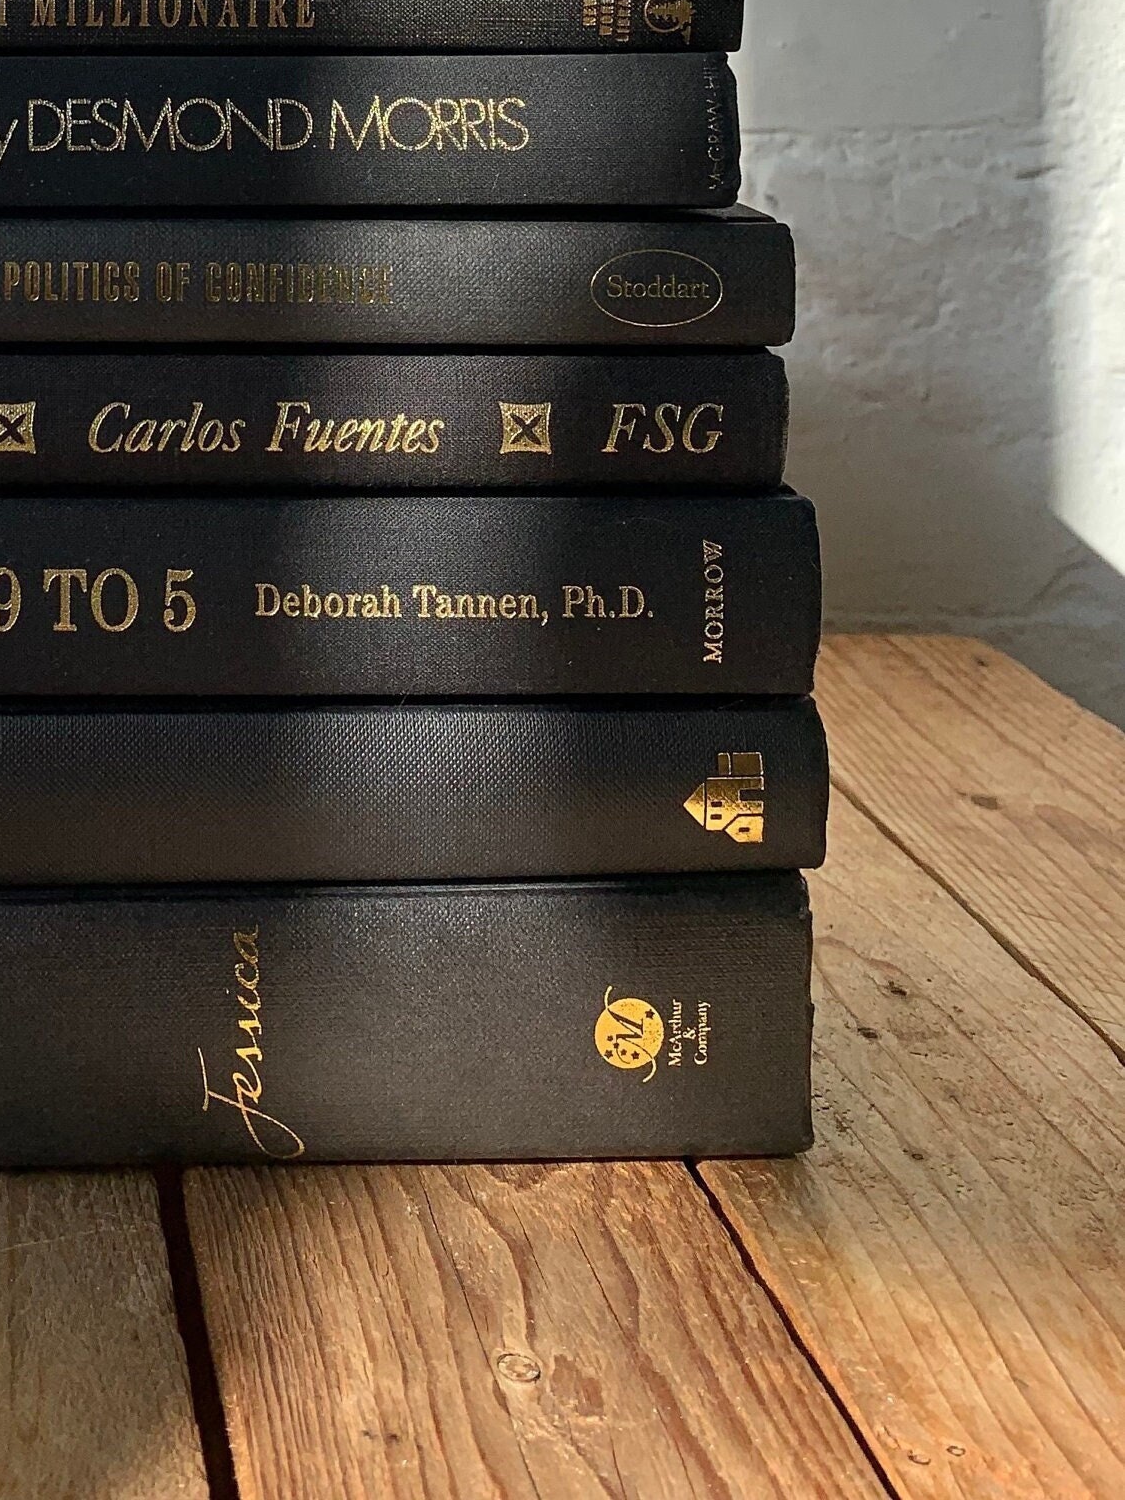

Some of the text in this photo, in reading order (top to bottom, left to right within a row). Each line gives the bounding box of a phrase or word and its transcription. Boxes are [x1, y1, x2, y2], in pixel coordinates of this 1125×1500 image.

[27, 97, 313, 152] DESMOND
[331, 97, 529, 151] MORRIS
[3, 260, 141, 303] POLITICS
[156, 263, 192, 302] OF
[205, 262, 393, 303] CONFIDENCE
[607, 274, 709, 300] Stoddart
[88, 402, 445, 454] Carlos Fuentes
[602, 403, 725, 453] FSG
[43, 567, 140, 634] TO
[164, 569, 196, 633] 5
[255, 584, 653, 625] Deborah Tannen, Ph.D.
[703, 541, 724, 663] MORROW
[197, 924, 306, 1159] Jessica
[668, 999, 682, 1067] McArthur
[683, 1027, 697, 1039] &
[693, 1000, 712, 1065] Company
